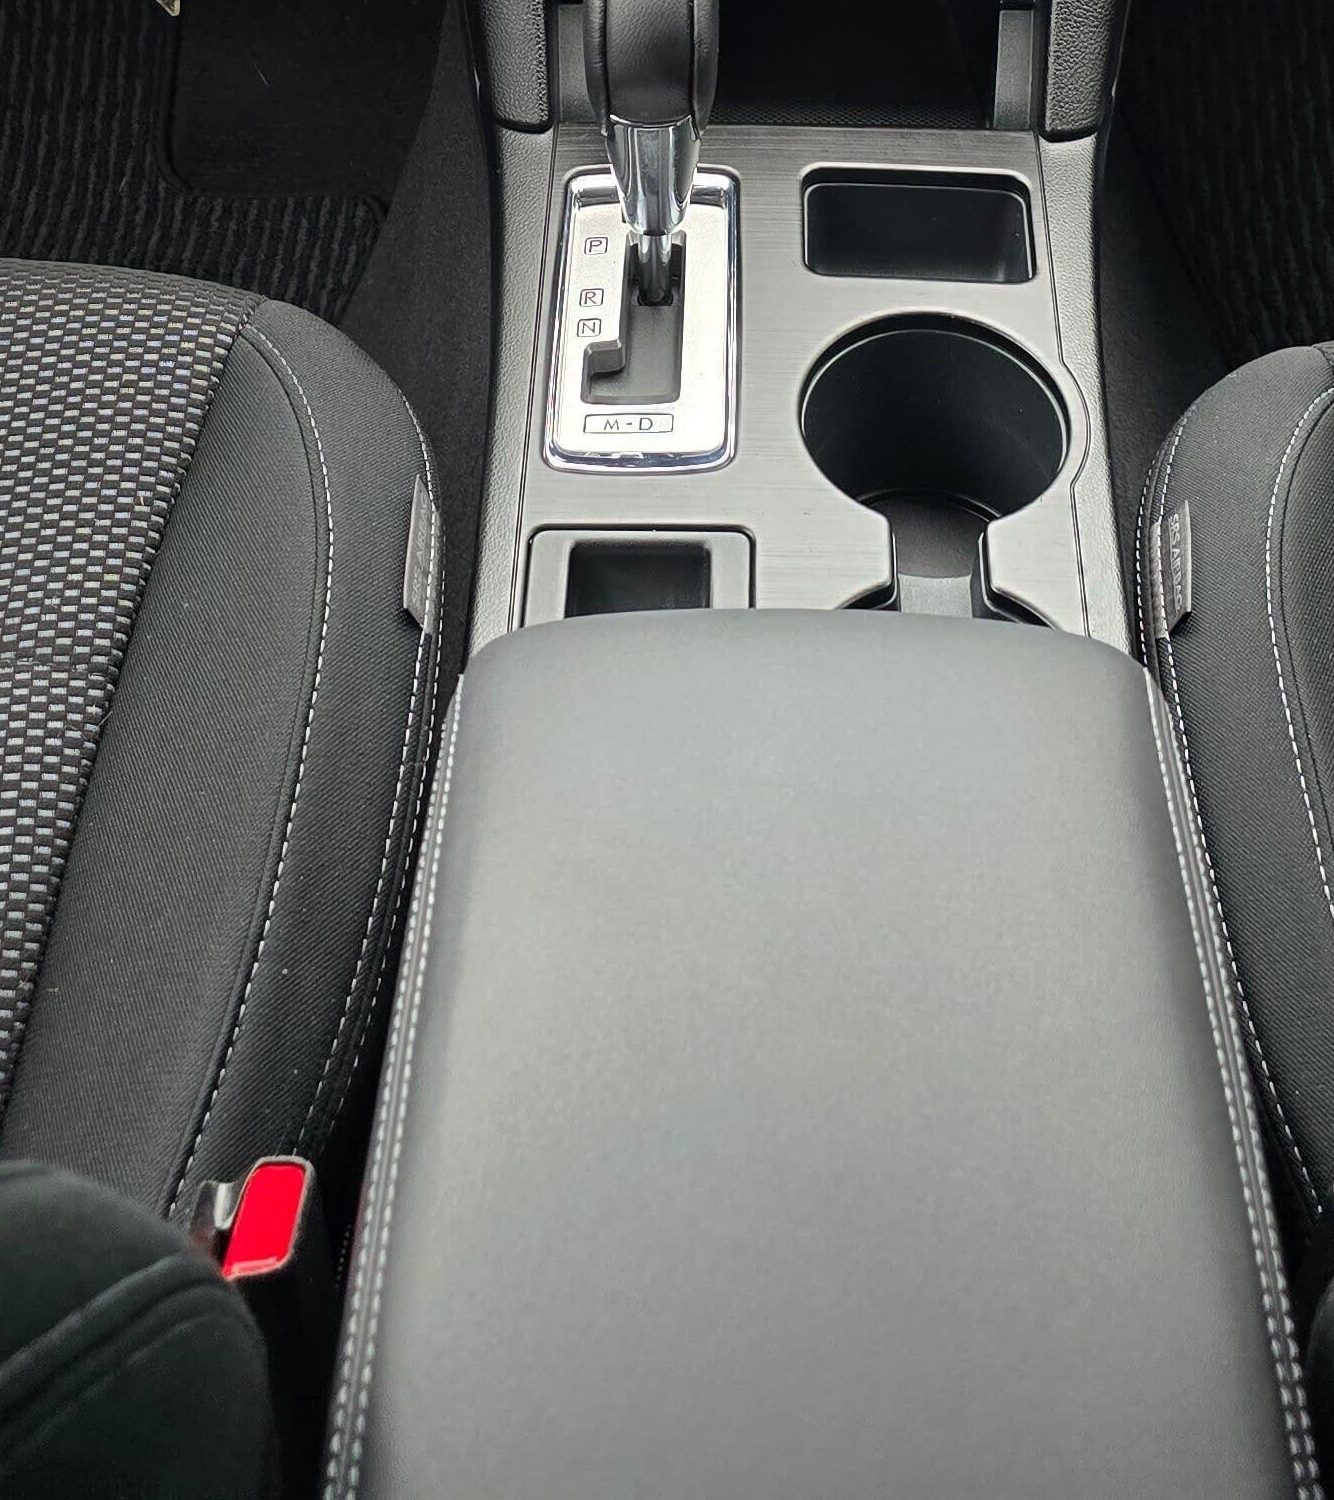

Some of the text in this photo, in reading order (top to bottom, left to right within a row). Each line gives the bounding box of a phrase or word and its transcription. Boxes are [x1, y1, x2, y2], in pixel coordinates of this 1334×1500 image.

[588, 239, 604, 252] P
[584, 291, 597, 305] R
[580, 321, 596, 334] N
[1168, 512, 1181, 546] SRS
